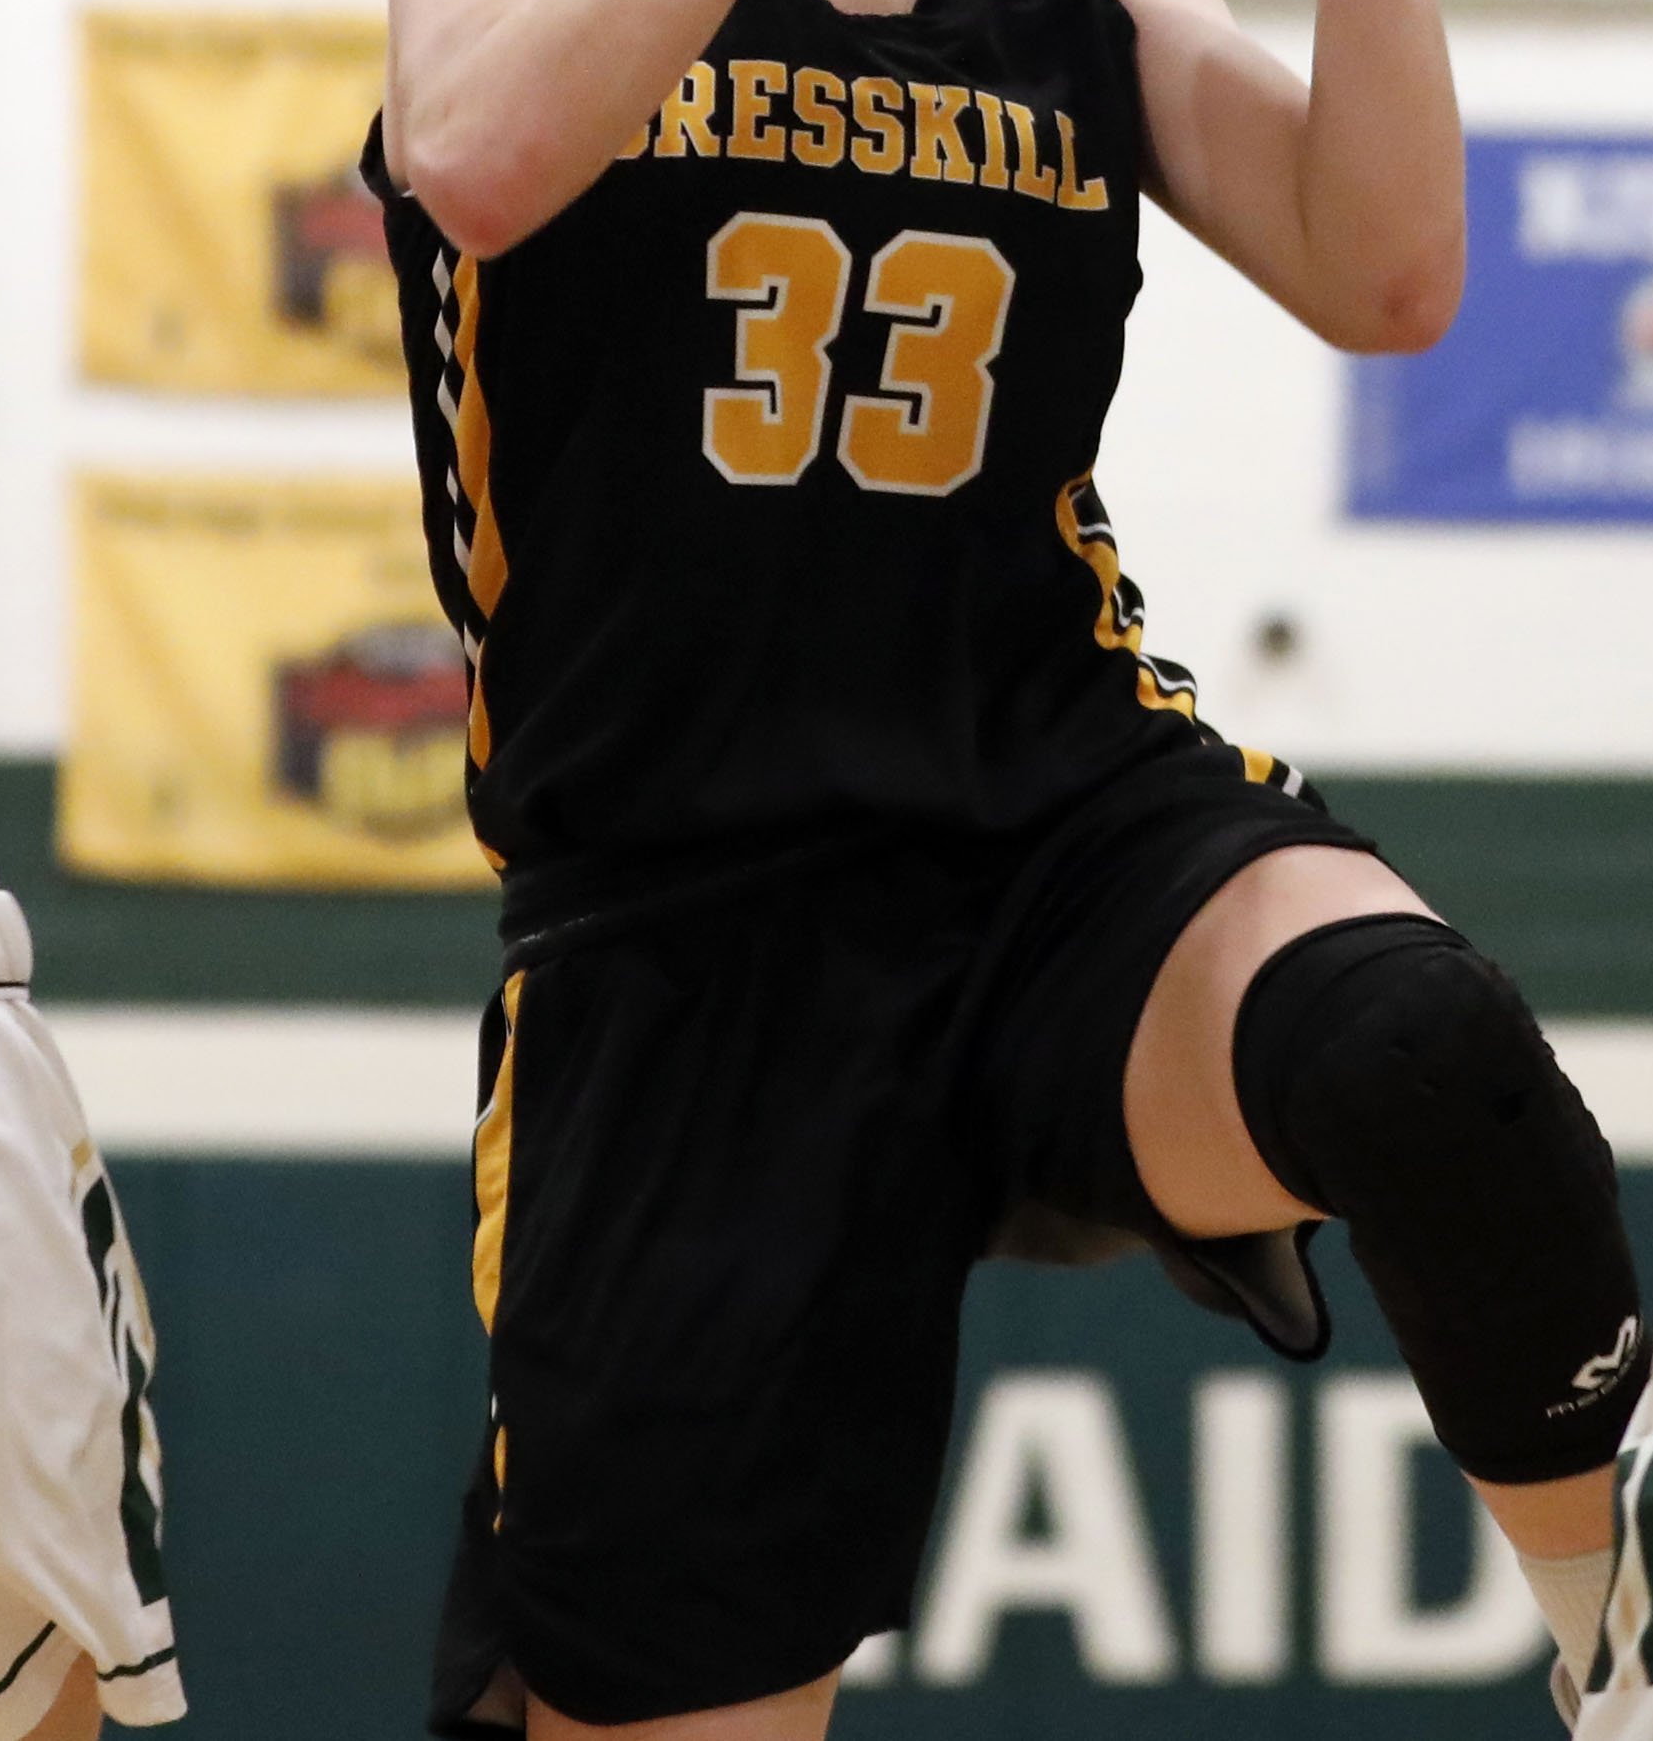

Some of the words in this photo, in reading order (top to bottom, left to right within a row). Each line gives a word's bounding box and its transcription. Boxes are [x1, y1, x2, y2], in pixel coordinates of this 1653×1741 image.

[616, 58, 1110, 212] RESSKILL
[702, 210, 1016, 497] 33
[841, 1370, 1551, 1686] AID
